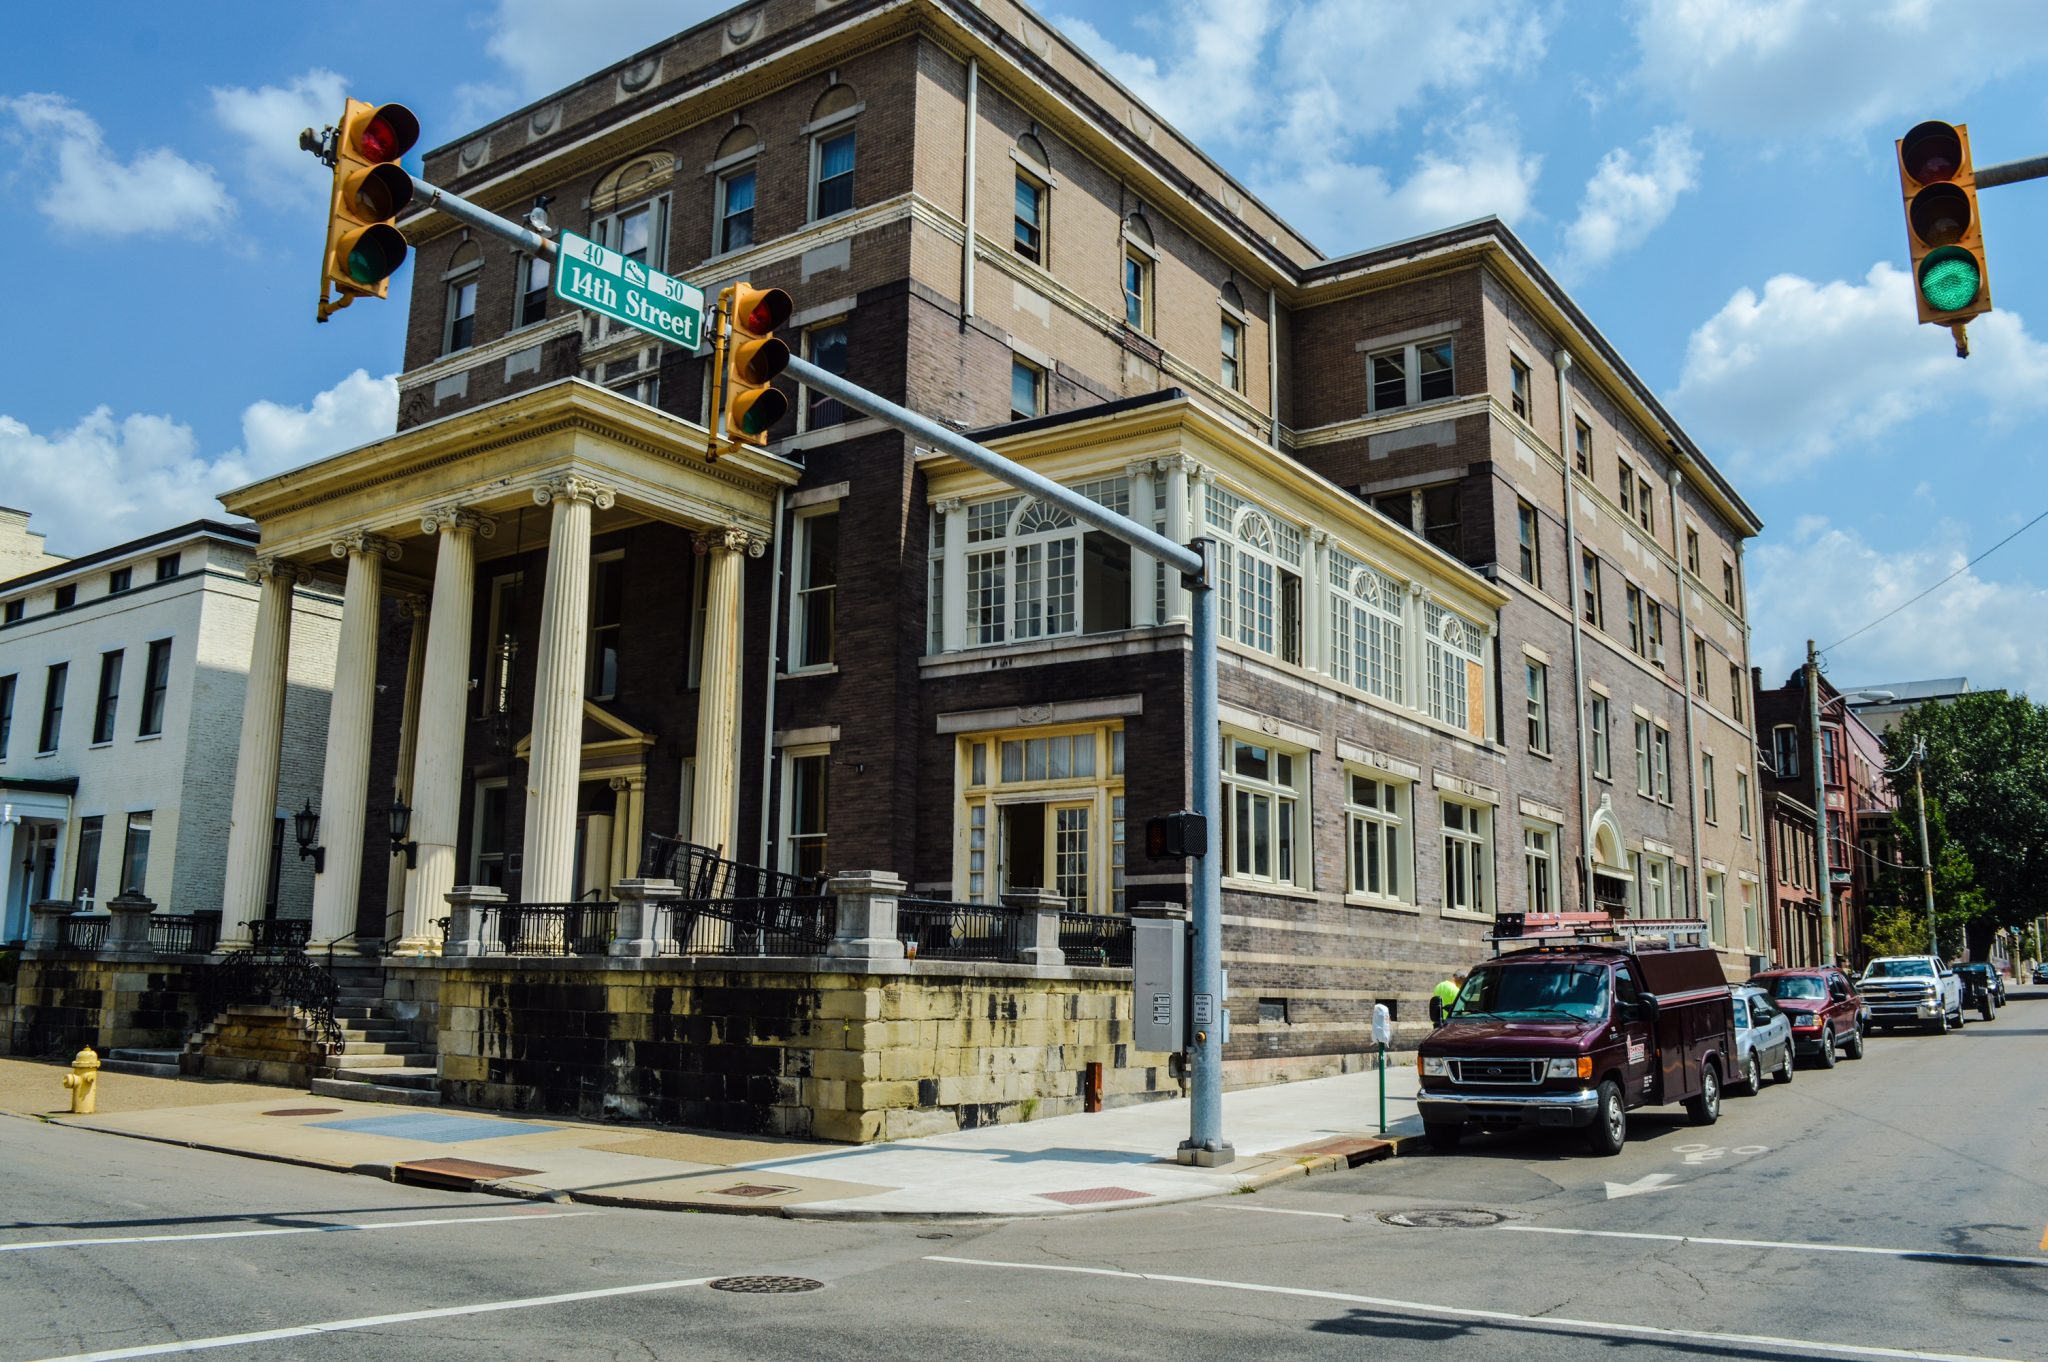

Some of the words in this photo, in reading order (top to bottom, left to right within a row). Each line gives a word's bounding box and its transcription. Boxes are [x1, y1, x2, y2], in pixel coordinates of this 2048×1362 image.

[583, 244, 604, 267] 40
[664, 279, 684, 301] 50
[570, 267, 617, 309] 14th
[625, 289, 693, 340] Street
